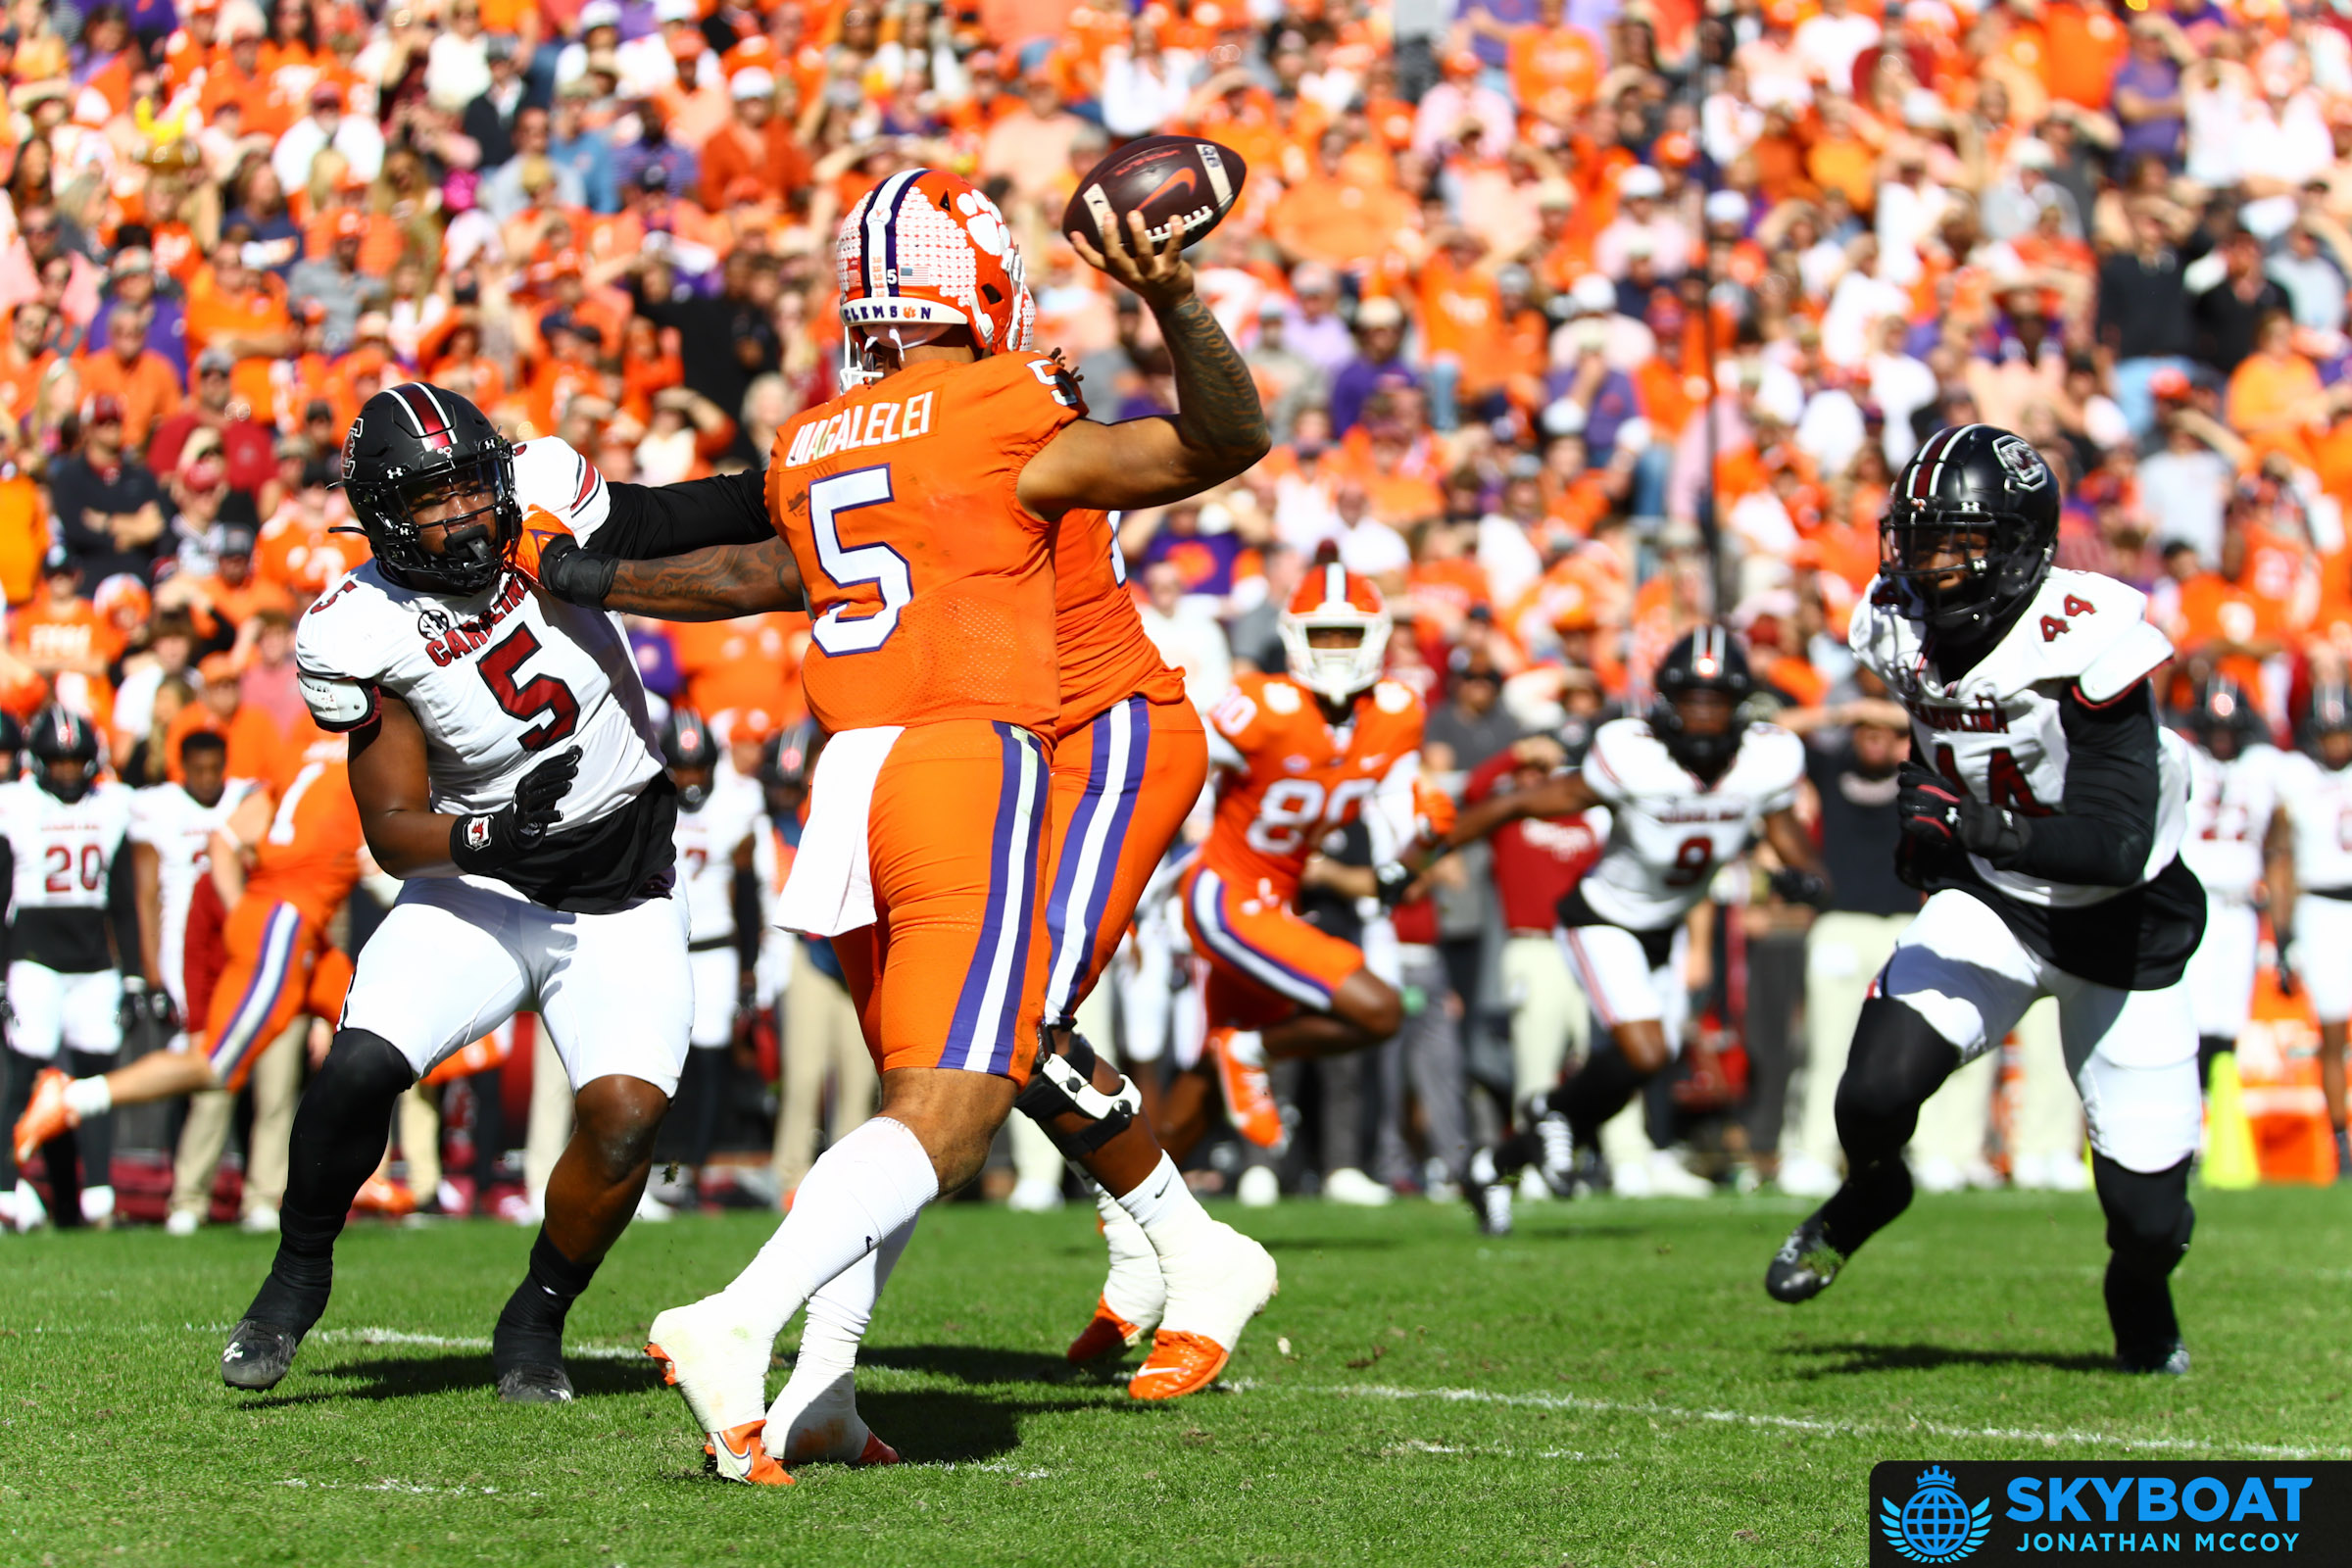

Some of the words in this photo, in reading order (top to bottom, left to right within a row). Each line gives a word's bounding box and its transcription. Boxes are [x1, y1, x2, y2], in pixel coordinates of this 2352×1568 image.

[887, 269, 898, 285] 5
[1026, 359, 1078, 407] 5
[785, 390, 934, 467] UIAGALELEI
[808, 463, 914, 659] 5
[310, 580, 358, 614] 5
[425, 573, 530, 667] CARLIN
[2040, 593, 2097, 643] 44
[475, 620, 581, 753] 5
[44, 843, 105, 893] 20
[1665, 836, 1713, 887] 9
